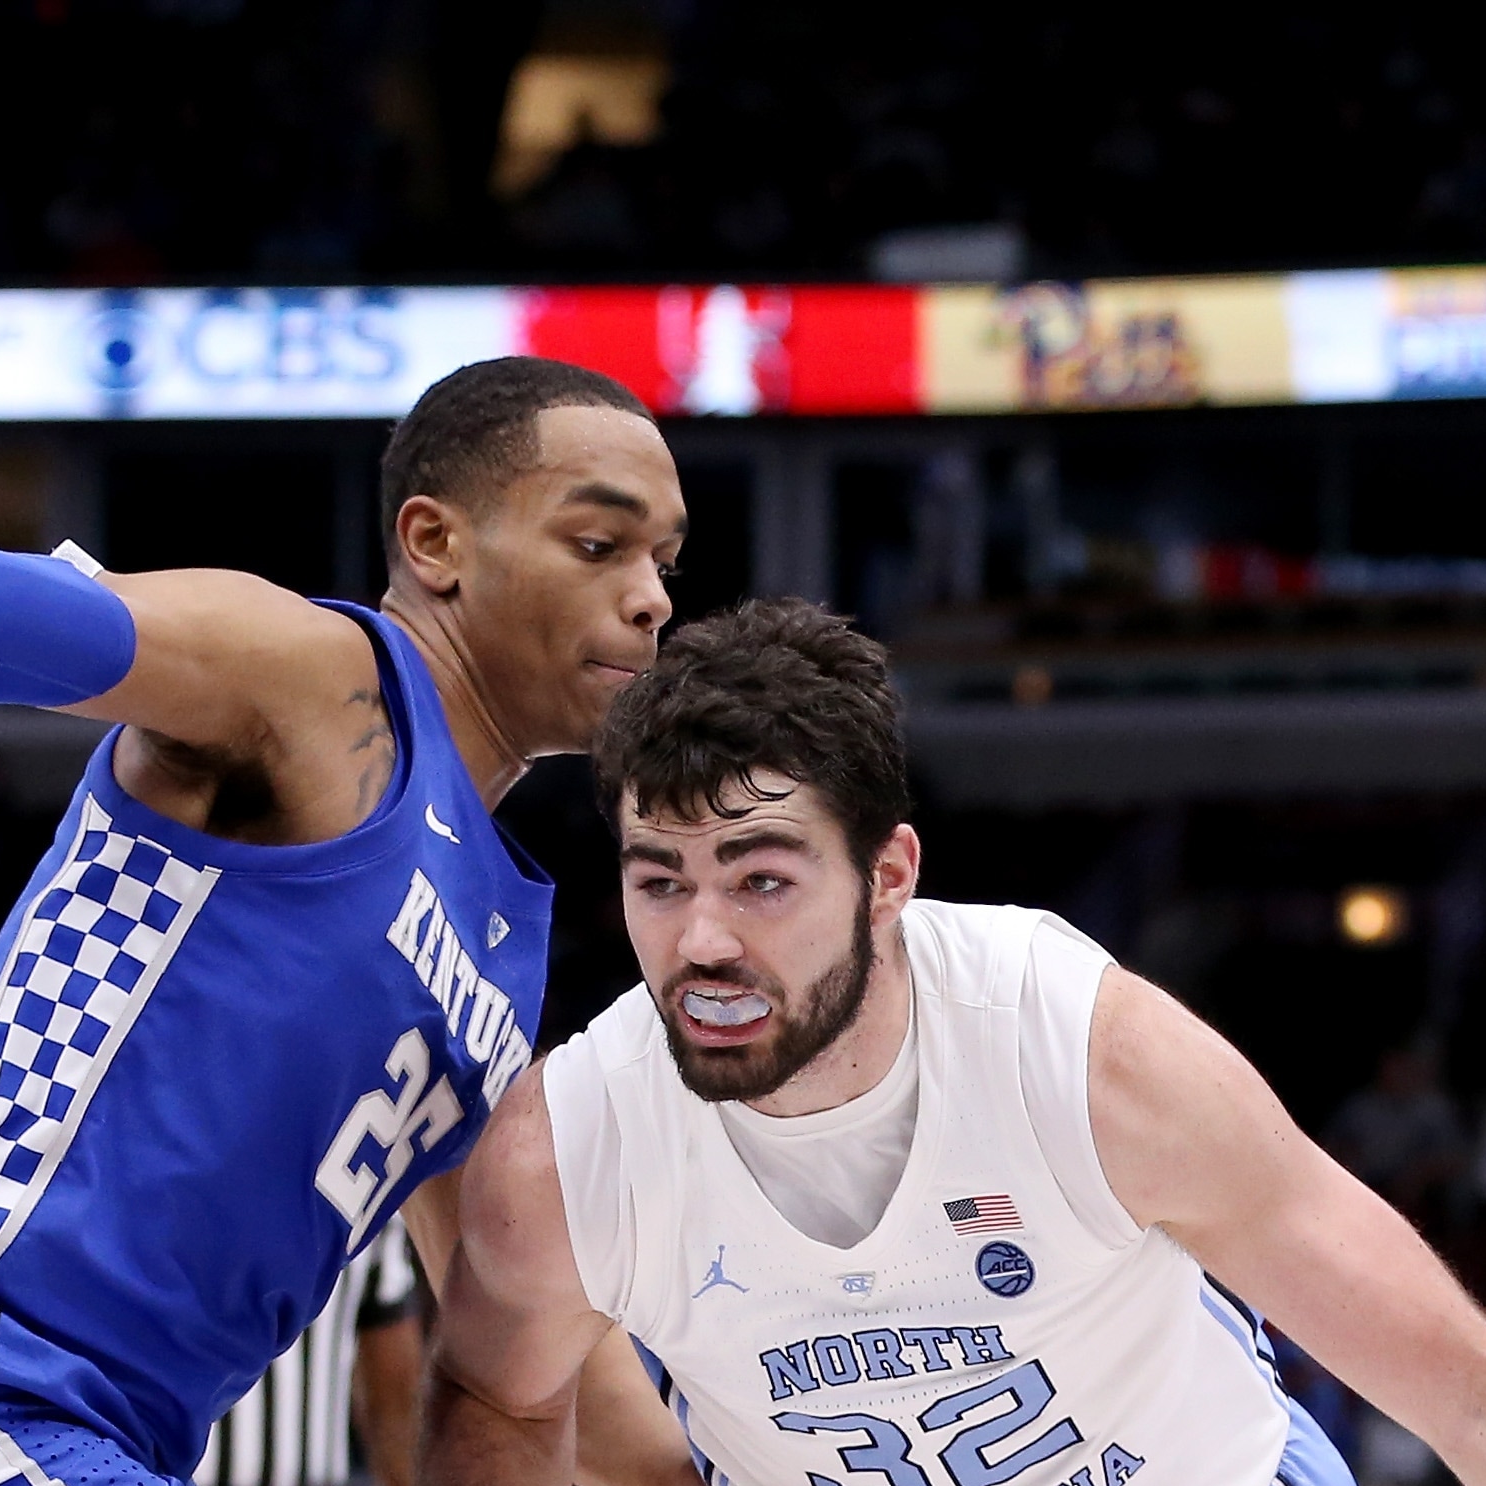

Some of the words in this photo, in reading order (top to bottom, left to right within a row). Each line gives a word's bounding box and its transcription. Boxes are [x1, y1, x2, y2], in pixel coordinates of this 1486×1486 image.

[178, 286, 406, 388] CBS
[385, 867, 533, 1112] KENTUCK
[314, 1026, 465, 1256] 25
[984, 1257, 1028, 1276] ACC
[759, 1325, 1015, 1401] NORTH
